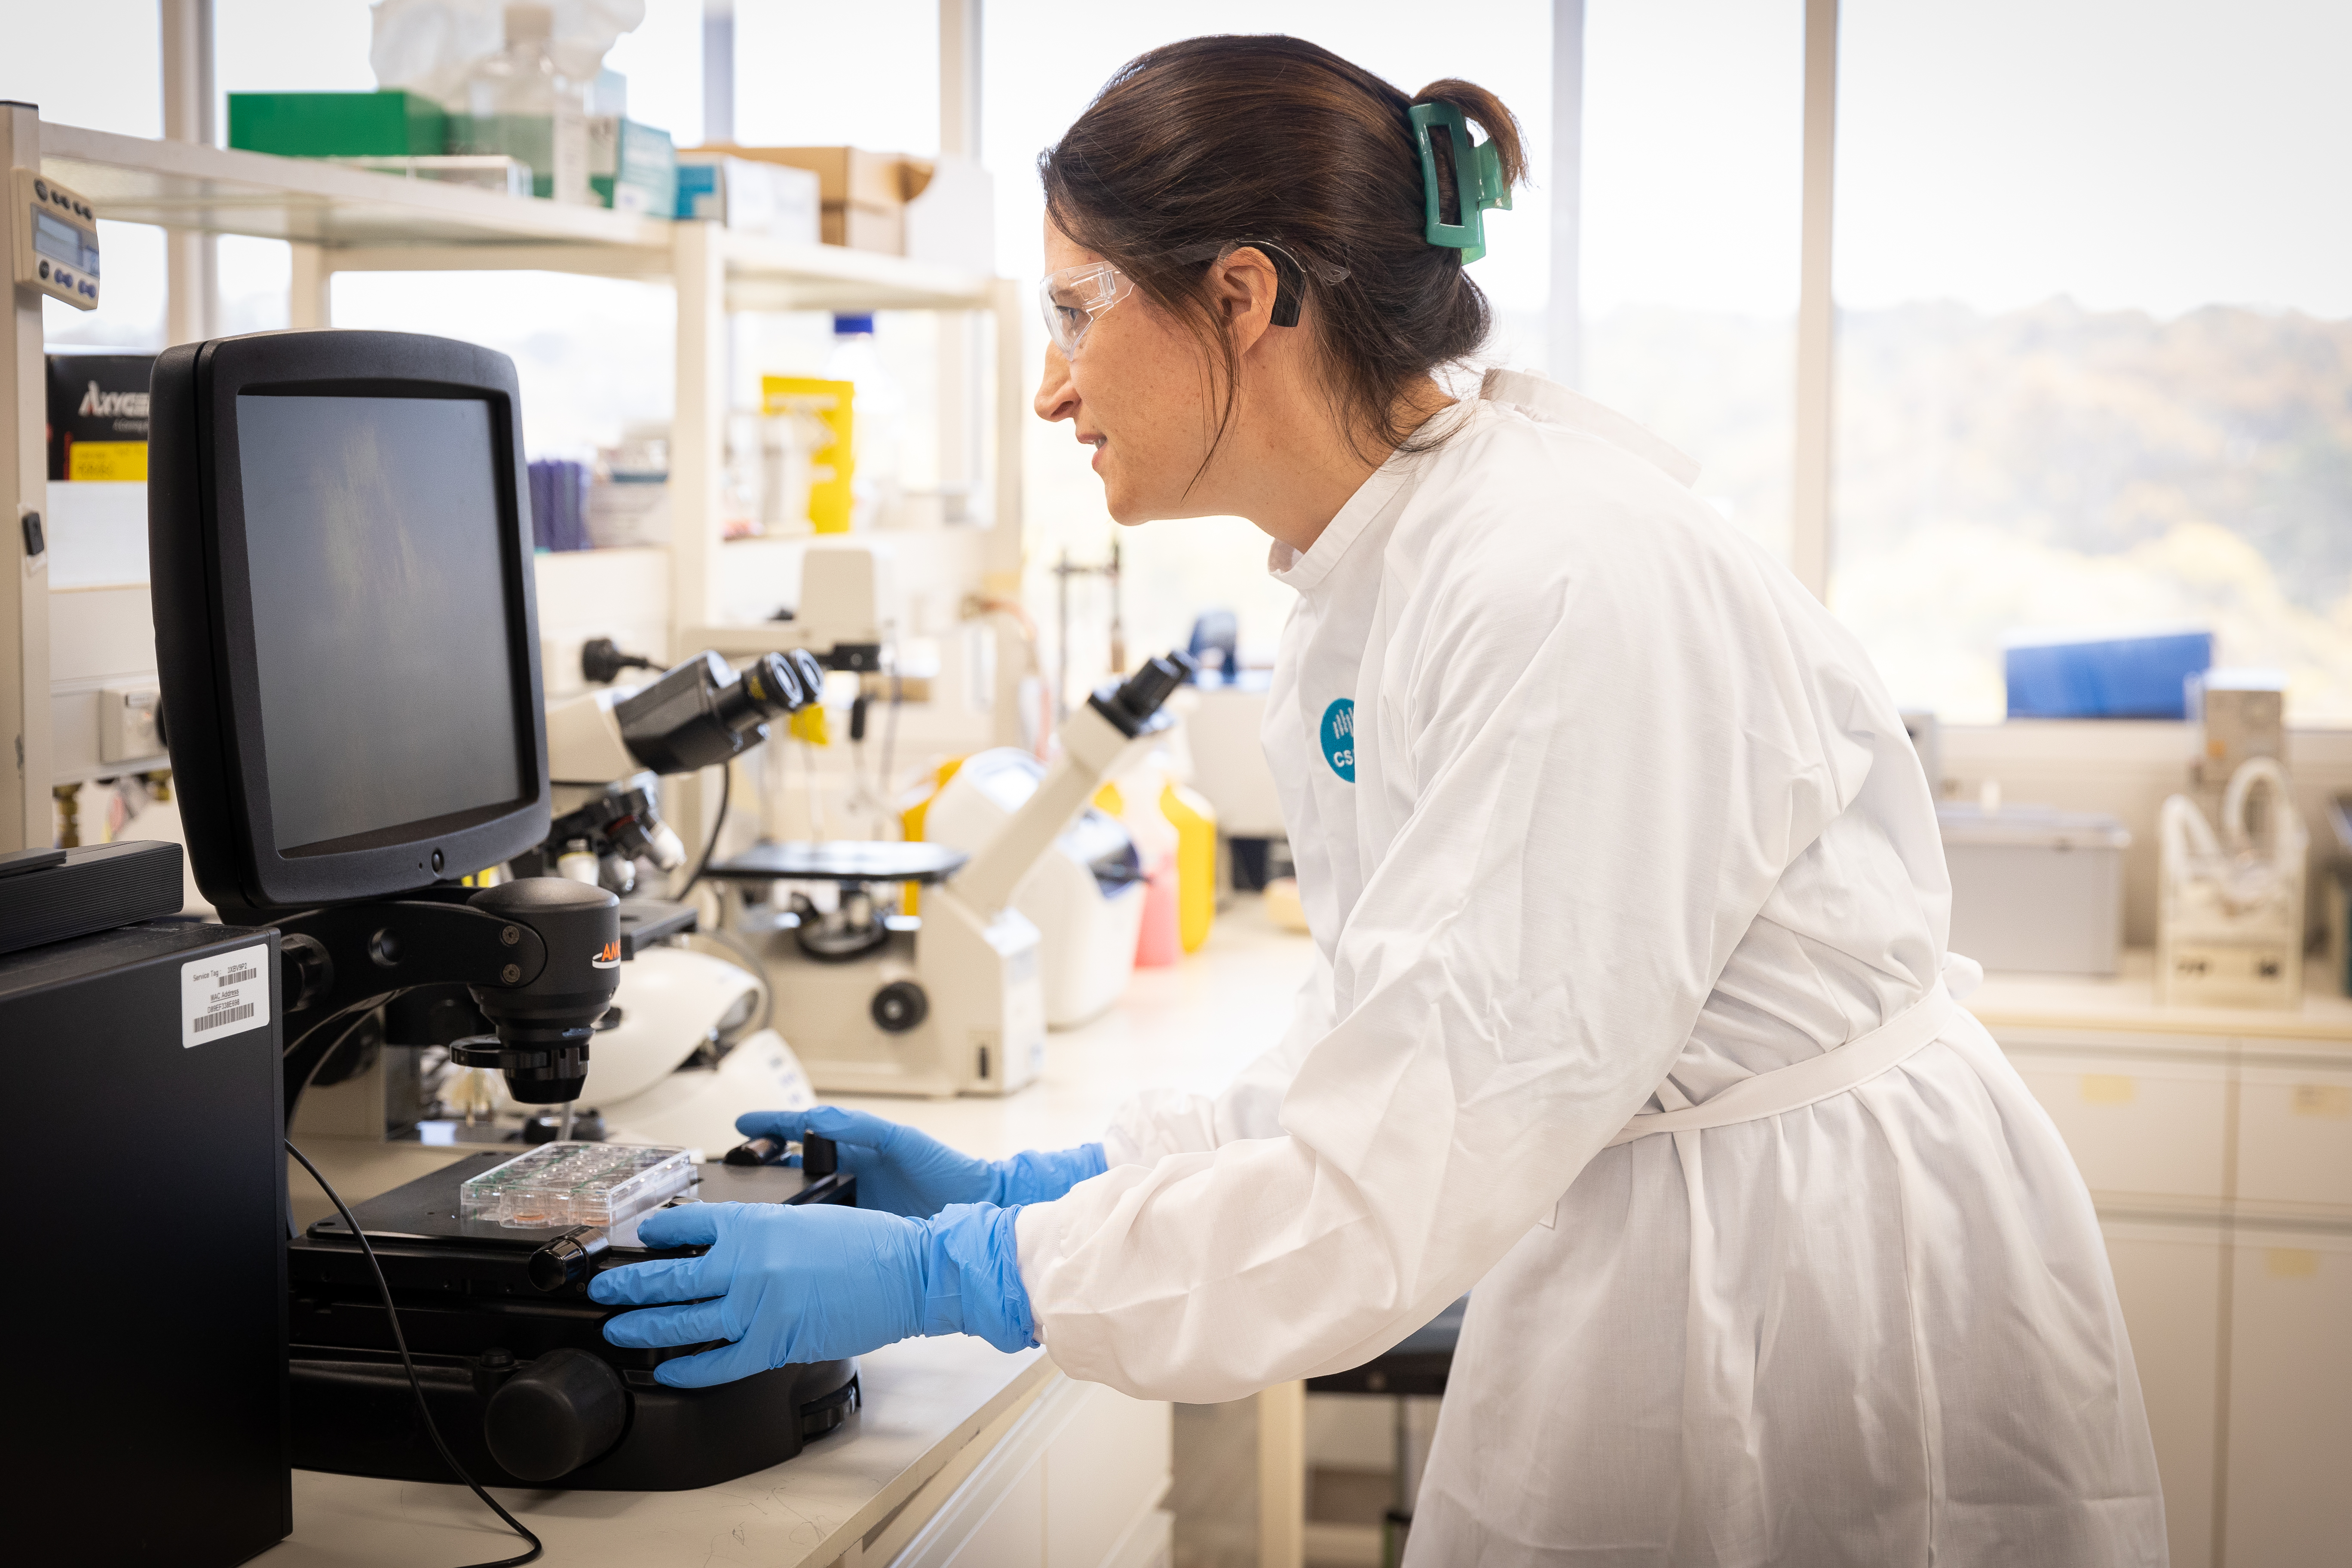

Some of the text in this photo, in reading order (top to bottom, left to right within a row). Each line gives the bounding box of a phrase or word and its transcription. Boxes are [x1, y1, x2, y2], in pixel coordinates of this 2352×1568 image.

[78, 380, 150, 416] AXYGE
[1333, 748, 1354, 768] CS
[601, 939, 621, 962] AM
[193, 973, 209, 981] Service
[211, 989, 239, 1001] MAC Address
